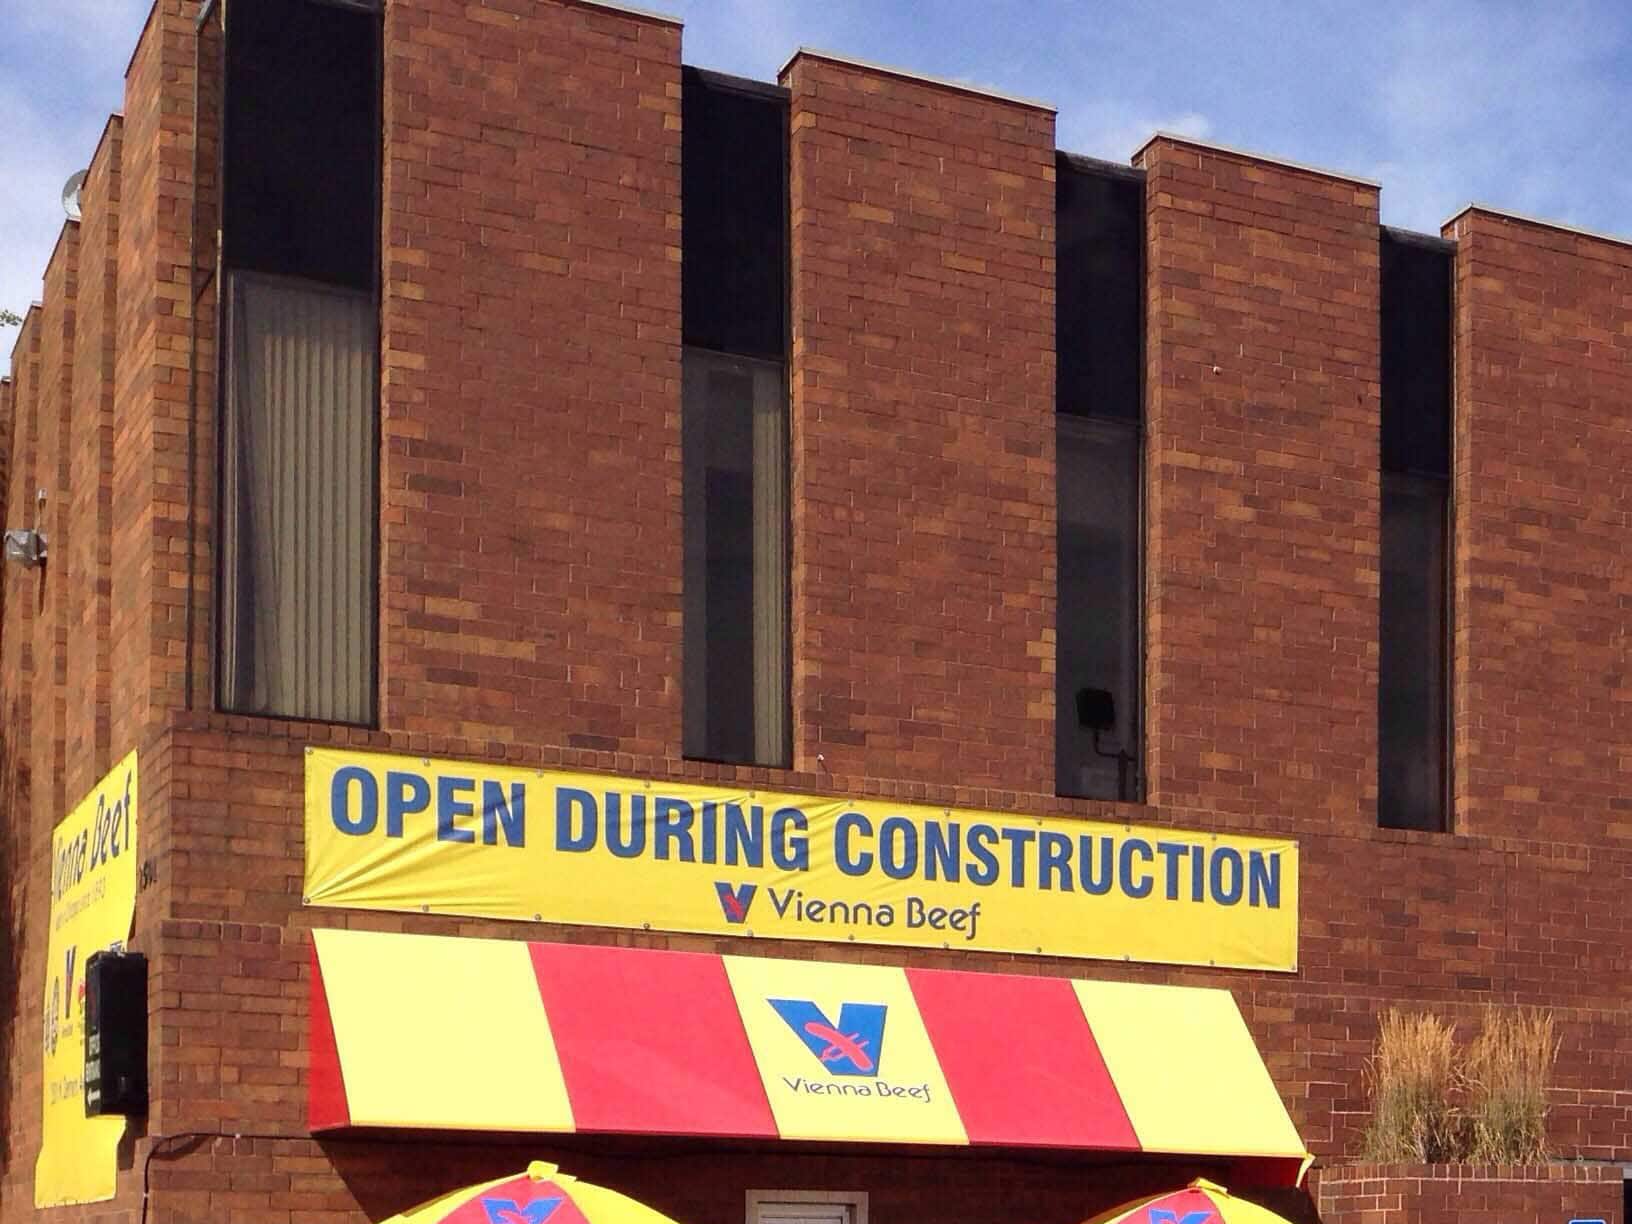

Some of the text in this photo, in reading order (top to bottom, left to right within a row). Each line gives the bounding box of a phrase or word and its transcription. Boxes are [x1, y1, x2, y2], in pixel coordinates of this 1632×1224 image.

[331, 766, 1281, 910] OPEN DURING CONSTRUCTION
[768, 888, 895, 928] Vienna
[906, 896, 981, 940] Beef
[783, 1076, 931, 1103] Vienna Beef
